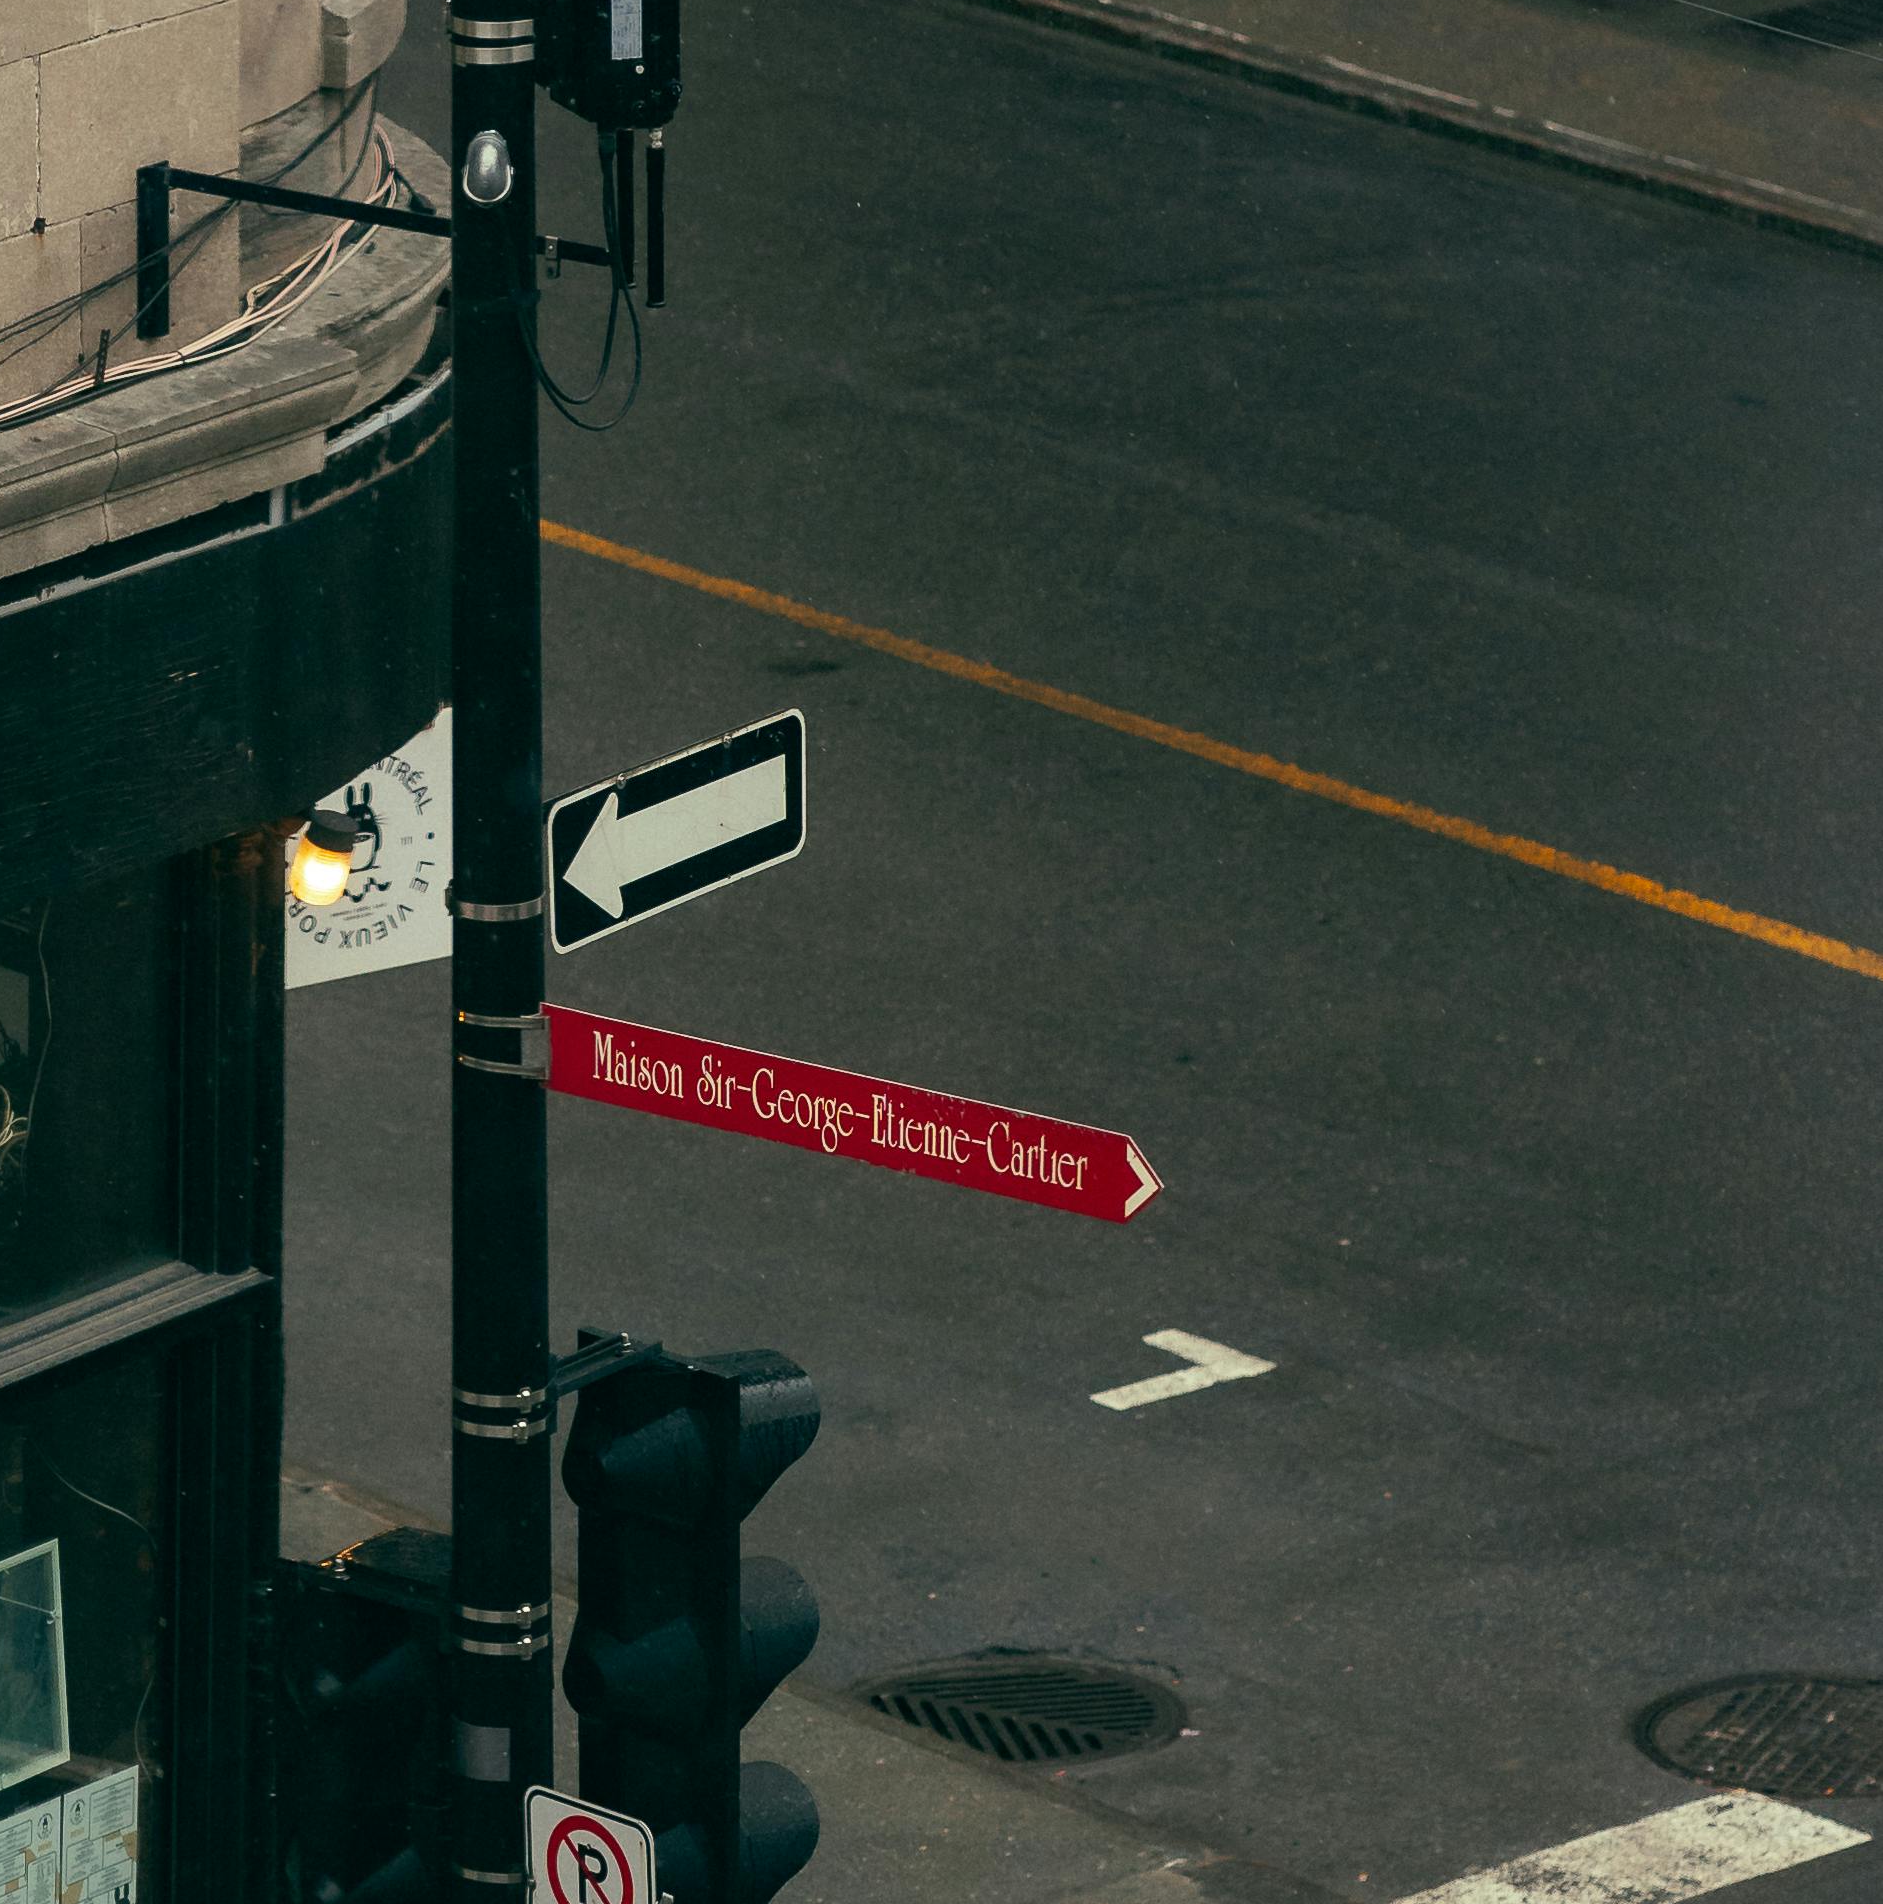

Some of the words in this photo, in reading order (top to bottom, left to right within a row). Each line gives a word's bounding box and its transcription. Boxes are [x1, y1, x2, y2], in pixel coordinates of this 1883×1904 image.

[409, 859, 436, 895] LE
[287, 898, 333, 946] POR
[337, 902, 415, 950] VIEUX
[592, 1028, 685, 1101] Maison
